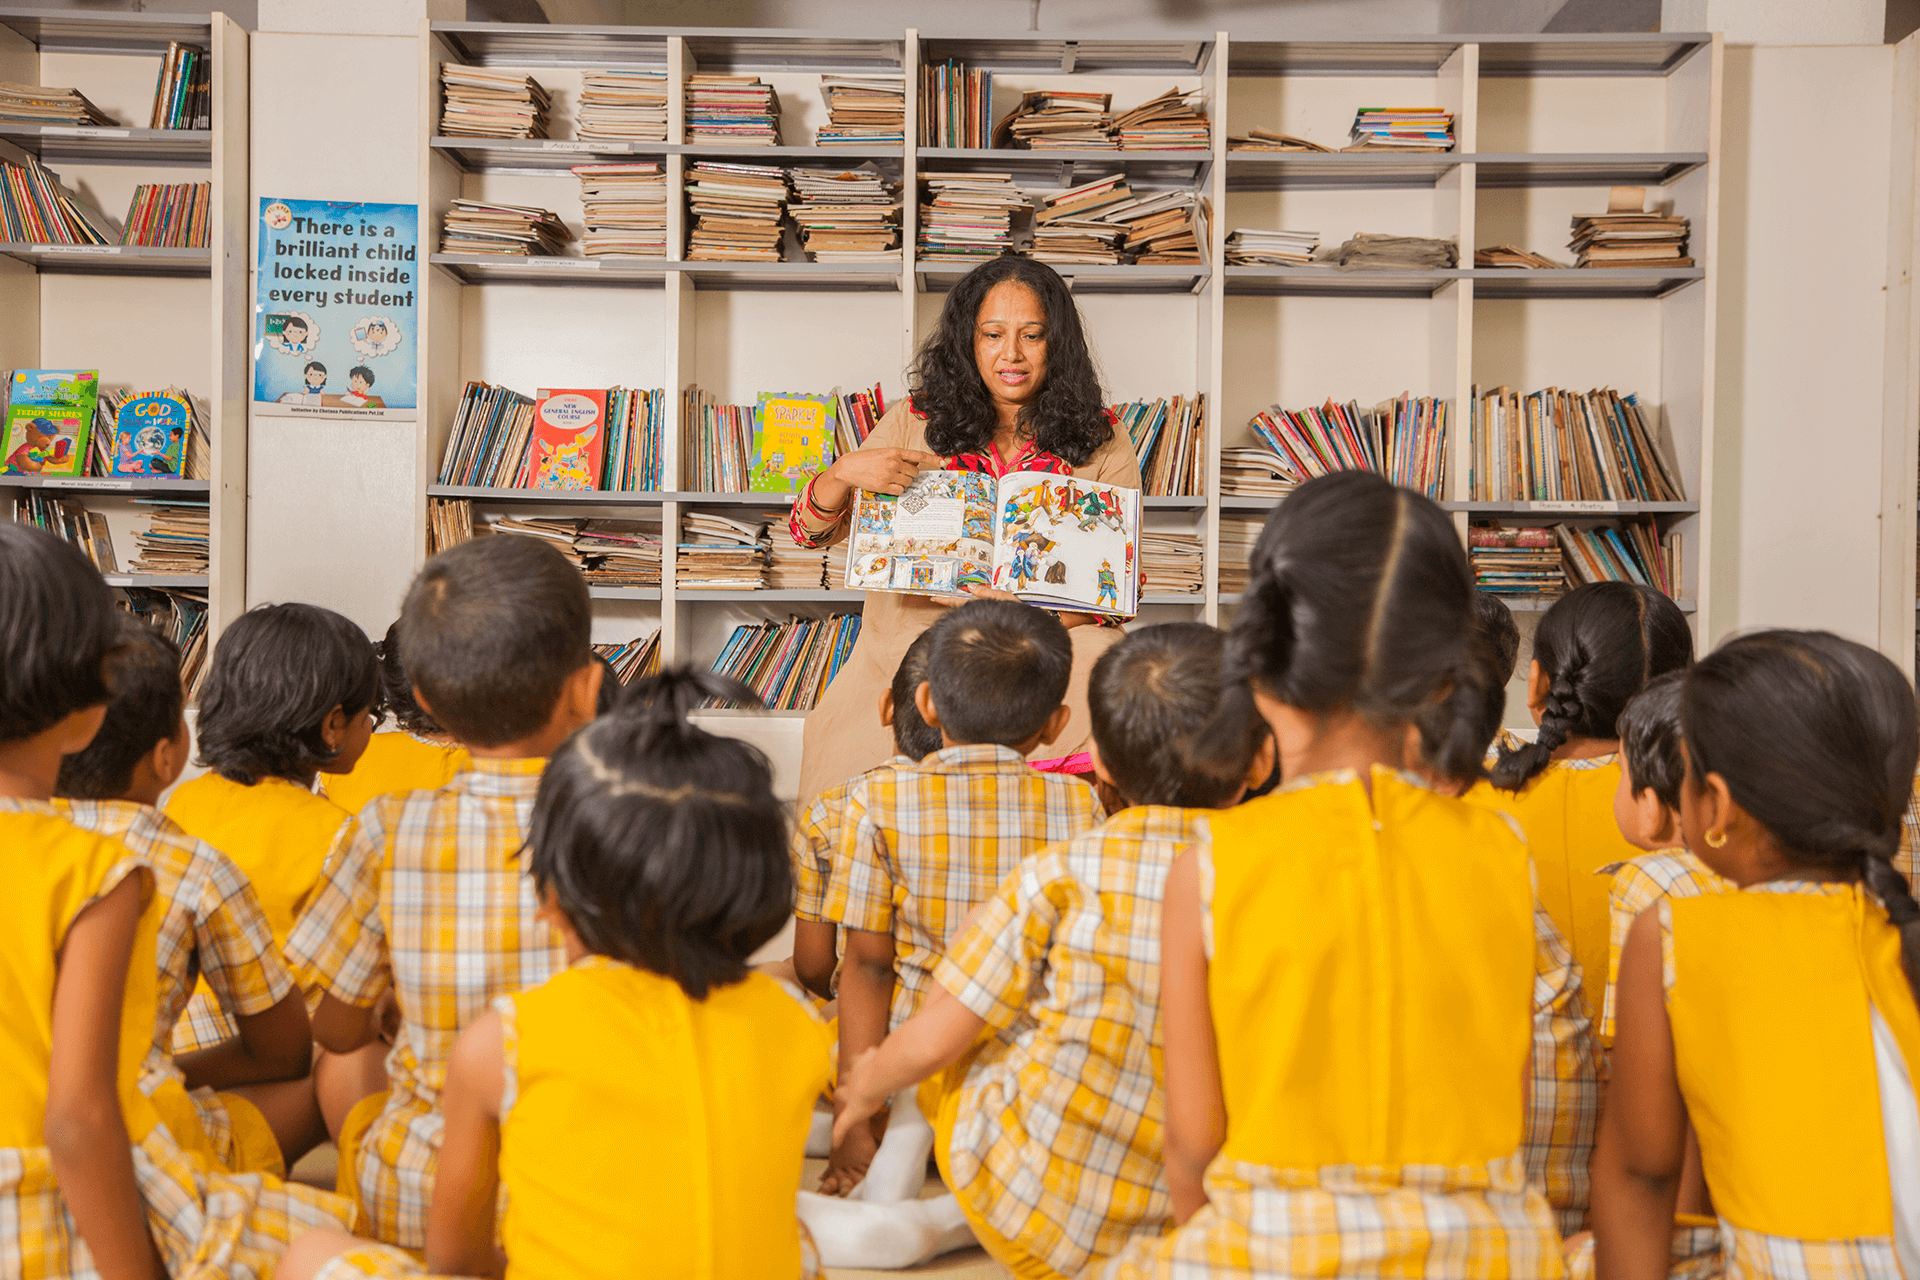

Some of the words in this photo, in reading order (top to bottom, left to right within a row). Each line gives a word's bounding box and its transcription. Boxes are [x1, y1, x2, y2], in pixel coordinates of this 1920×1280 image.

[292, 218, 354, 235] There
[360, 220, 377, 237] is
[384, 226, 395, 237] a
[276, 240, 359, 259] brilliant
[366, 245, 416, 262] child
[274, 262, 342, 282] locked
[348, 265, 410, 284] inside
[269, 288, 328, 308] every
[334, 289, 414, 307] student
[135, 403, 171, 417] GOD
[774, 405, 817, 423] SPARKLE
